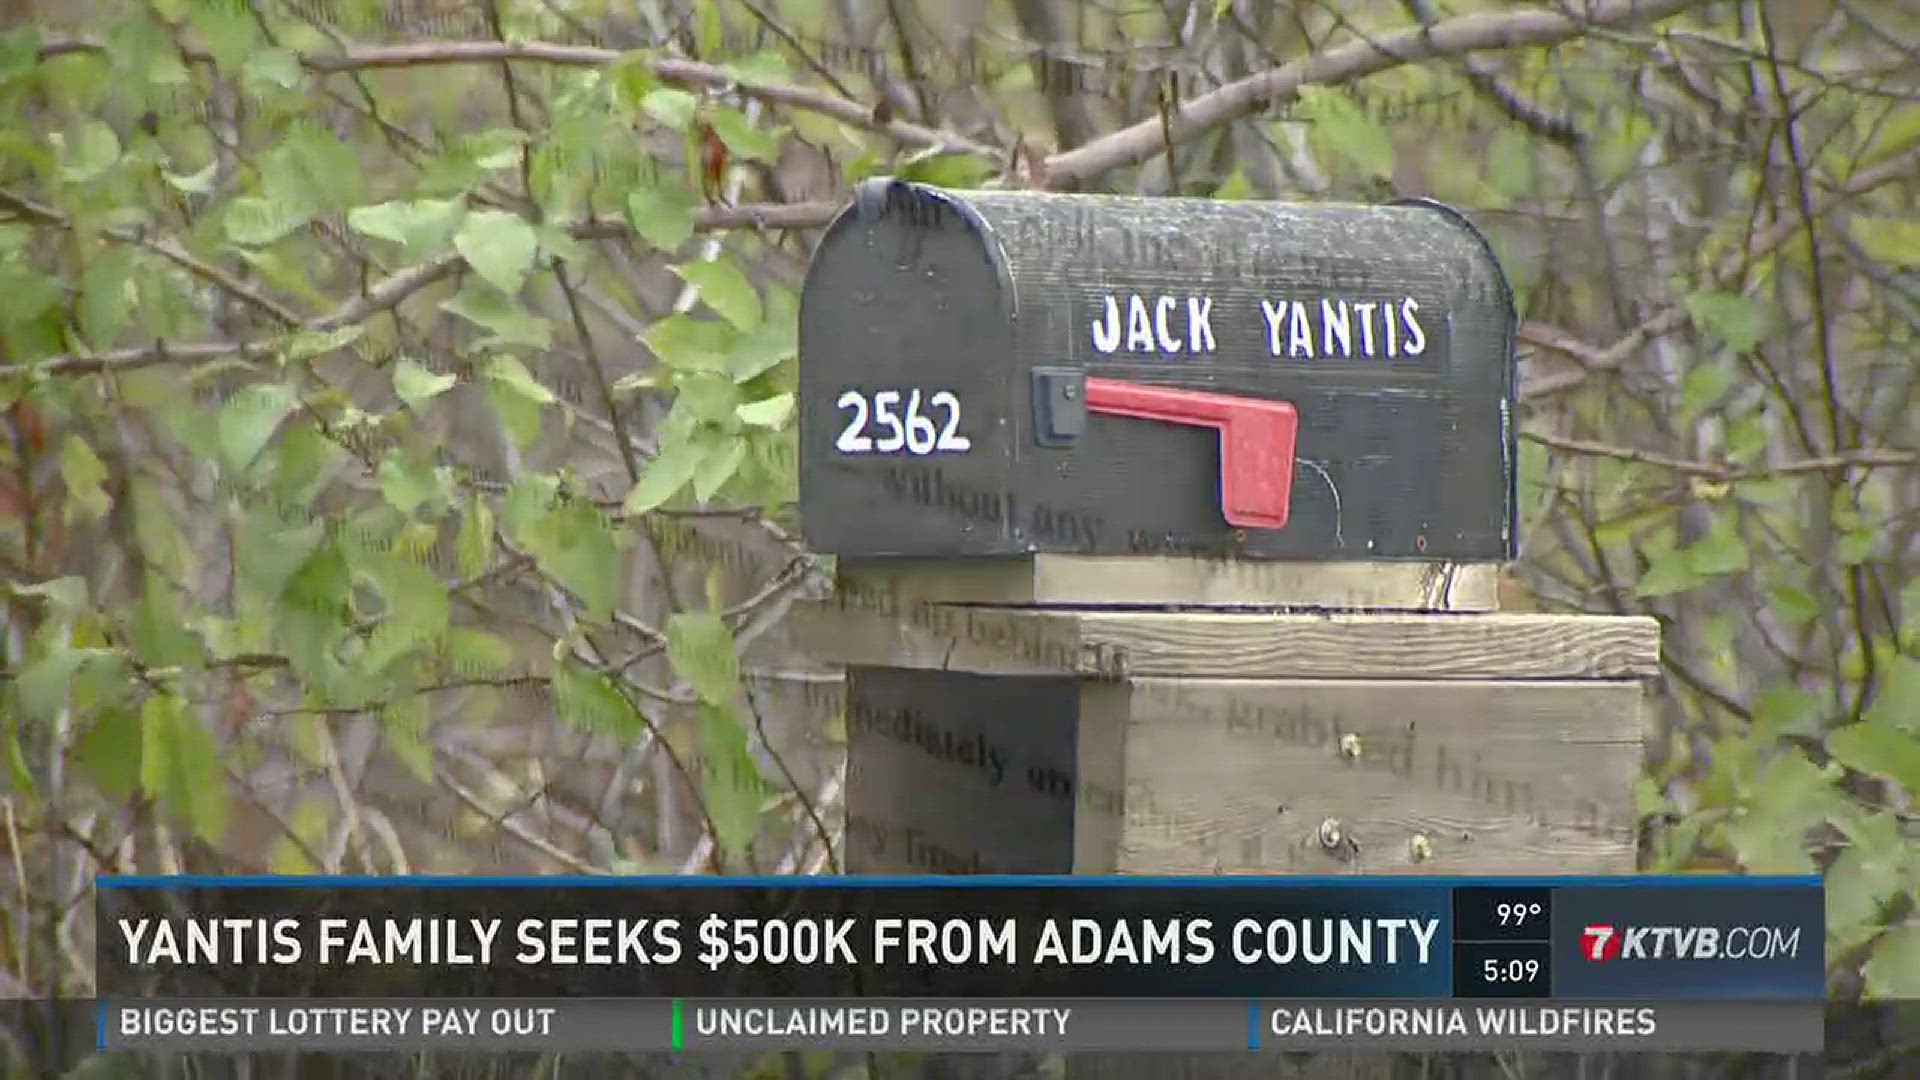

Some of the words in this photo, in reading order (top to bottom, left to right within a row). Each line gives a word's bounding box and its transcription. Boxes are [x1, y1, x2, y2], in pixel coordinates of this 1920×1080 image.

[1091, 294, 1215, 353] JACK
[1260, 295, 1428, 358] YANTIS
[835, 388, 971, 455] 2562
